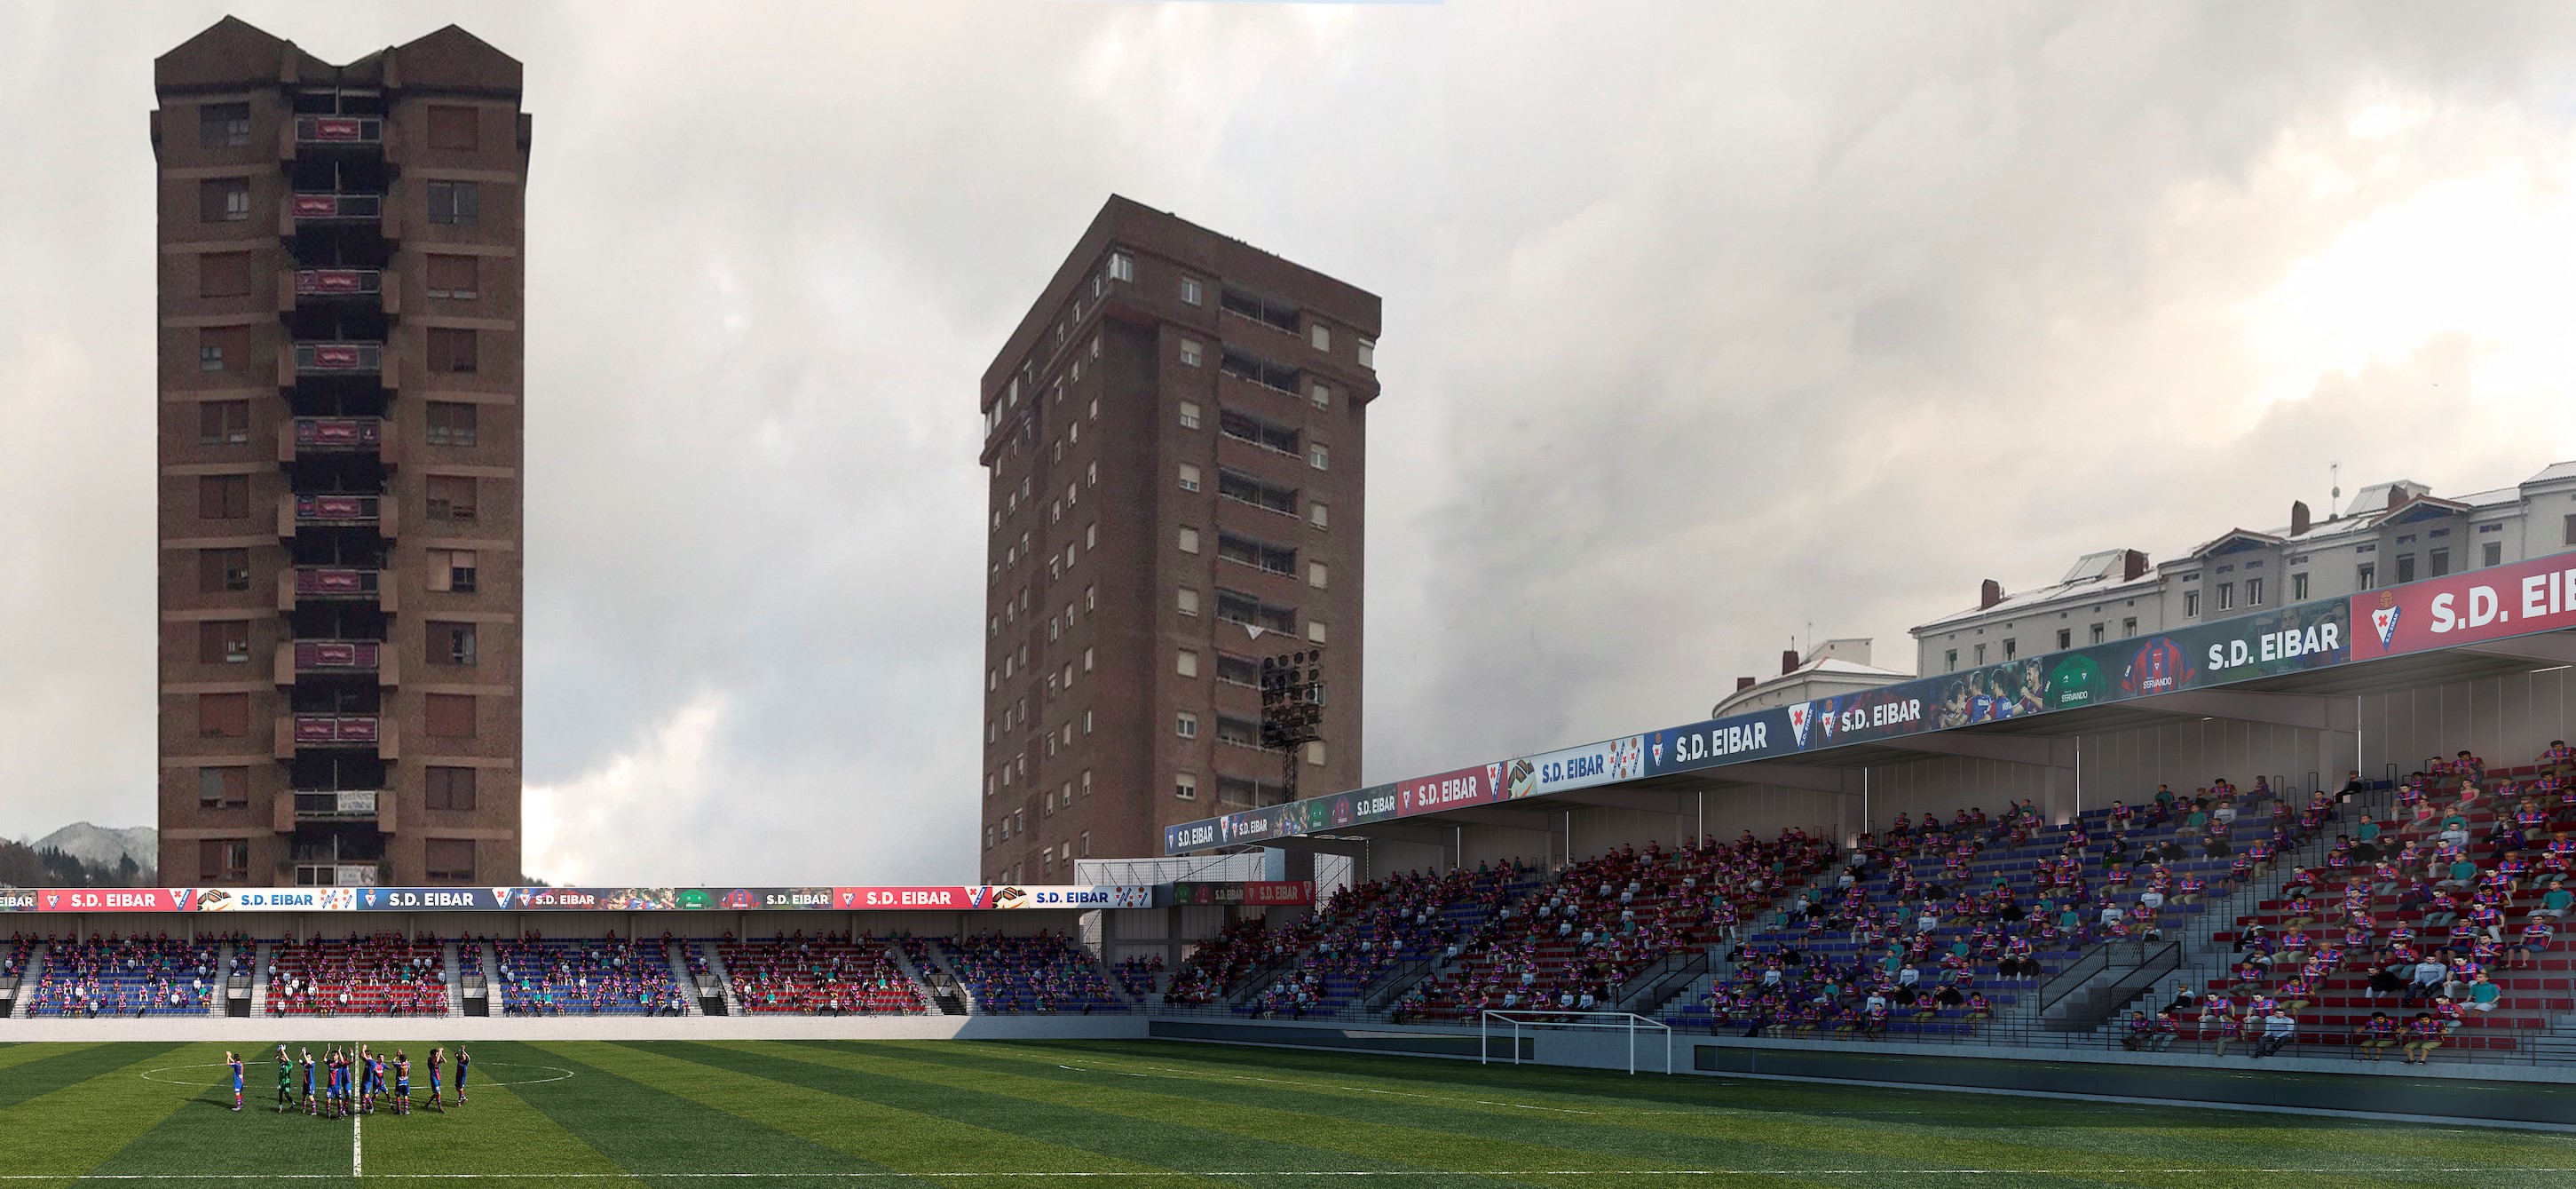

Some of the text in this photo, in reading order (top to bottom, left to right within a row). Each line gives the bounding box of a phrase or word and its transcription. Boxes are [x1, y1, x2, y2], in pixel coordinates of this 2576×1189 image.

[2430, 585, 2509, 633] S.D.
[2208, 622, 2340, 670] S.D. EIBAR
[2143, 677, 2172, 689] SERVANDO
[2061, 690, 2088, 702] SERVANDO
[1841, 709, 1870, 733] S.D.
[1873, 698, 1921, 726] EIBAR
[1676, 733, 1708, 763] S.D.
[1712, 721, 1767, 757] EIBAR
[1542, 762, 1564, 784] S.D.
[1567, 754, 1604, 780] EIBAR
[1418, 775, 1477, 806] S.D. EIBAR
[1357, 796, 1395, 816] S.D. EIBAR
[1238, 818, 1268, 836] S.D. EIBAR
[1178, 825, 1213, 847] S.D. EIBAR
[71, 893, 156, 908] S.D. EIBAR
[241, 894, 313, 906] S.D. EIBAR
[389, 892, 474, 907] S.D. EIBAR
[535, 895, 595, 905] S.D. EIBAR
[766, 894, 829, 905] S.D. EIBAR
[866, 892, 952, 905] S.D. EIBAR
[1036, 892, 1109, 903] S.D. EIBAR
[1215, 889, 1244, 900] S.D. EIBAR
[1260, 886, 1298, 900] S.D. EIBAR
